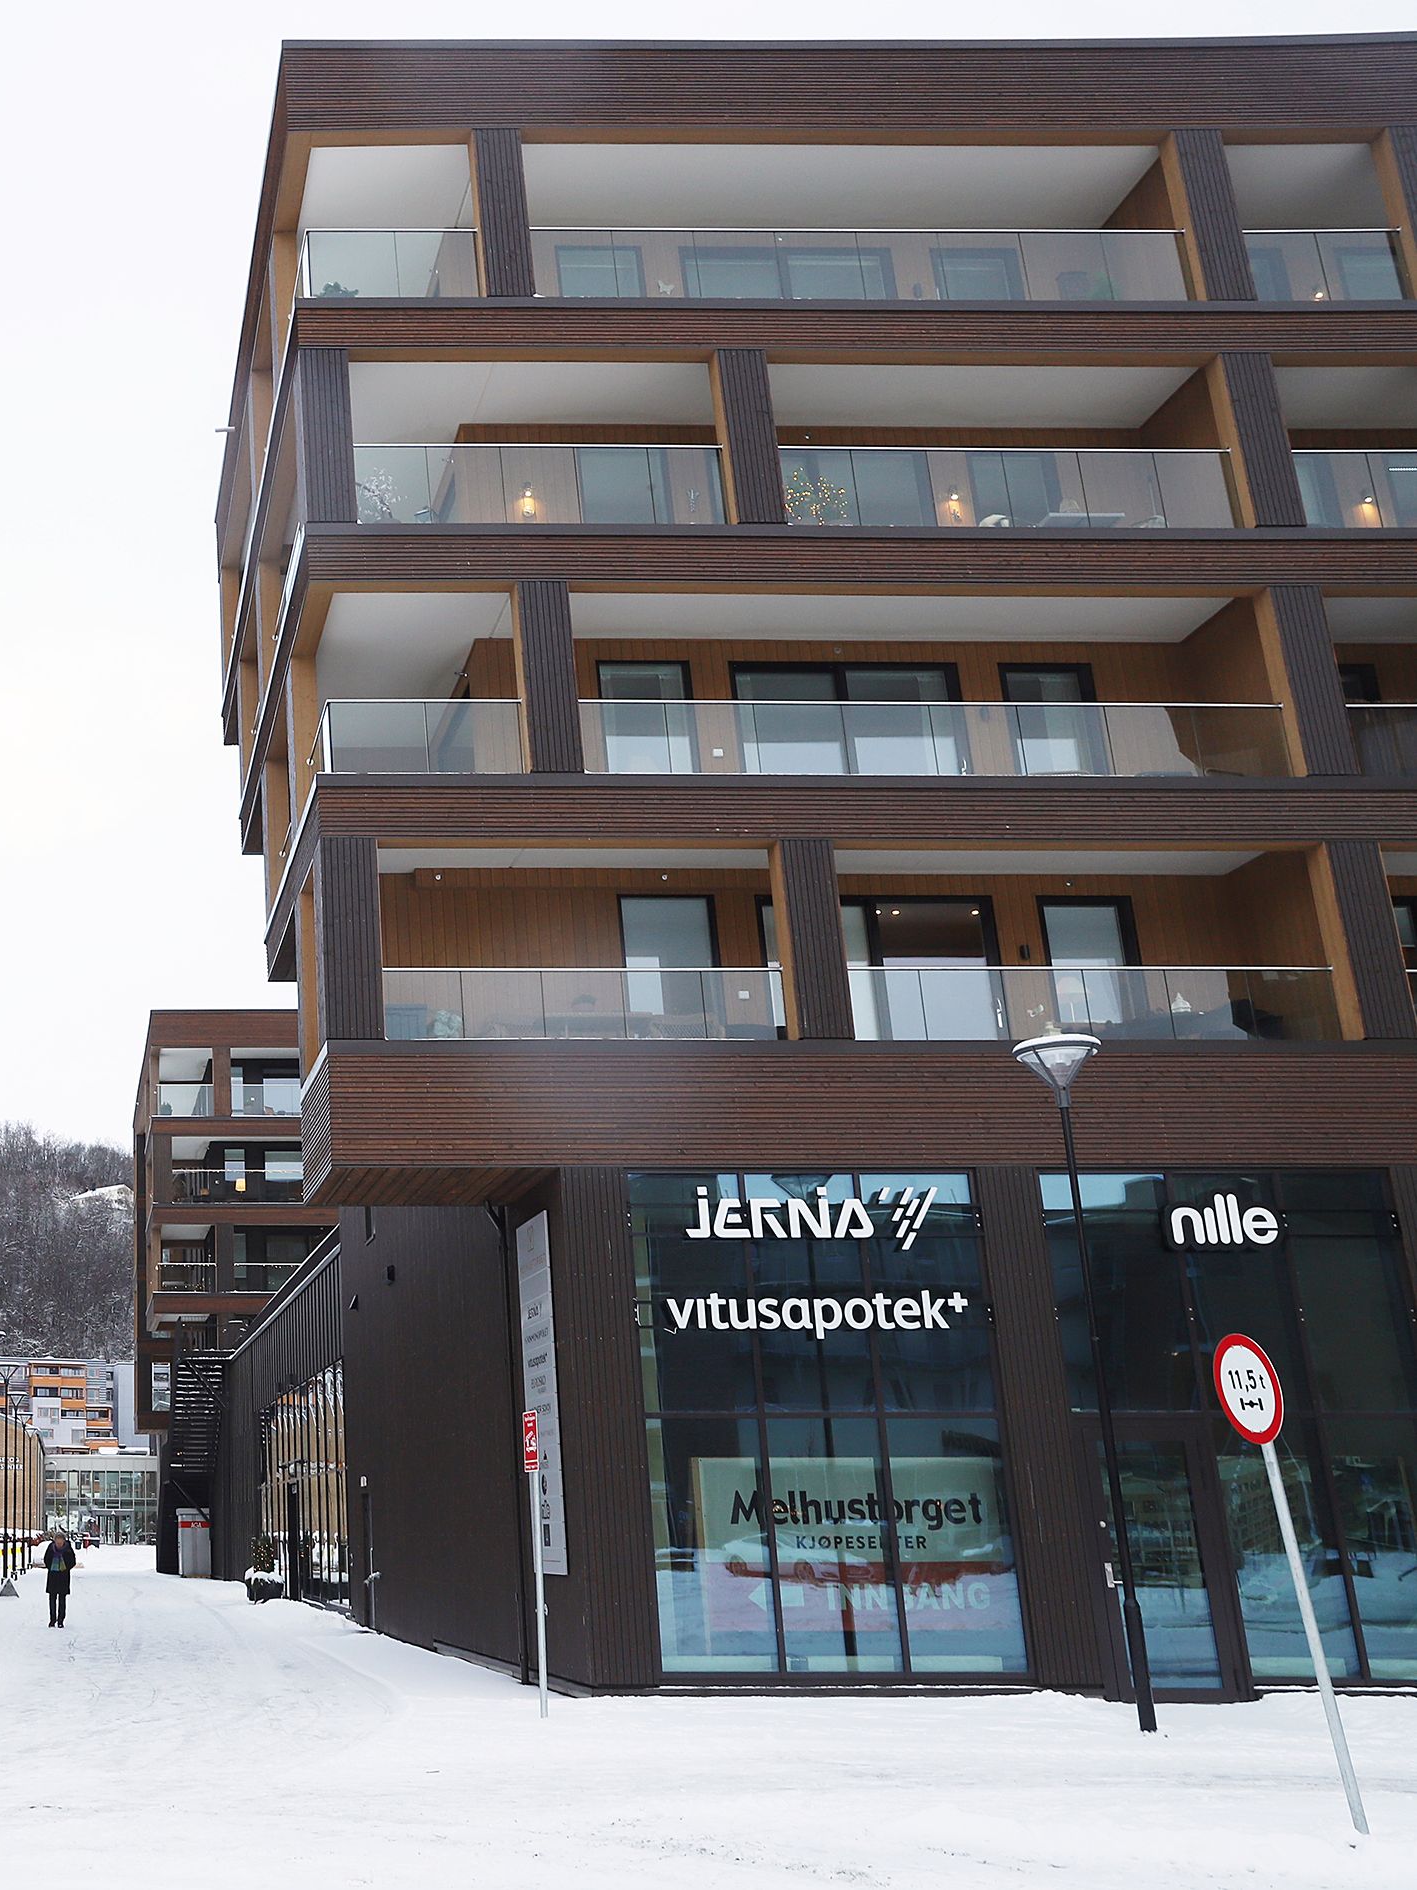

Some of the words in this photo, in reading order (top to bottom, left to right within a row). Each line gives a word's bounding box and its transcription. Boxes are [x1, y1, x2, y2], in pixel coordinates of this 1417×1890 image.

[1170, 1193, 1279, 1245] nille
[666, 1289, 969, 1340] vitusapotek+
[1227, 1369, 1257, 1392] 11,5
[1258, 1374, 1266, 1389] t
[730, 1489, 983, 1531] Melhustorget
[795, 1535, 927, 1549] KJØPESEER
